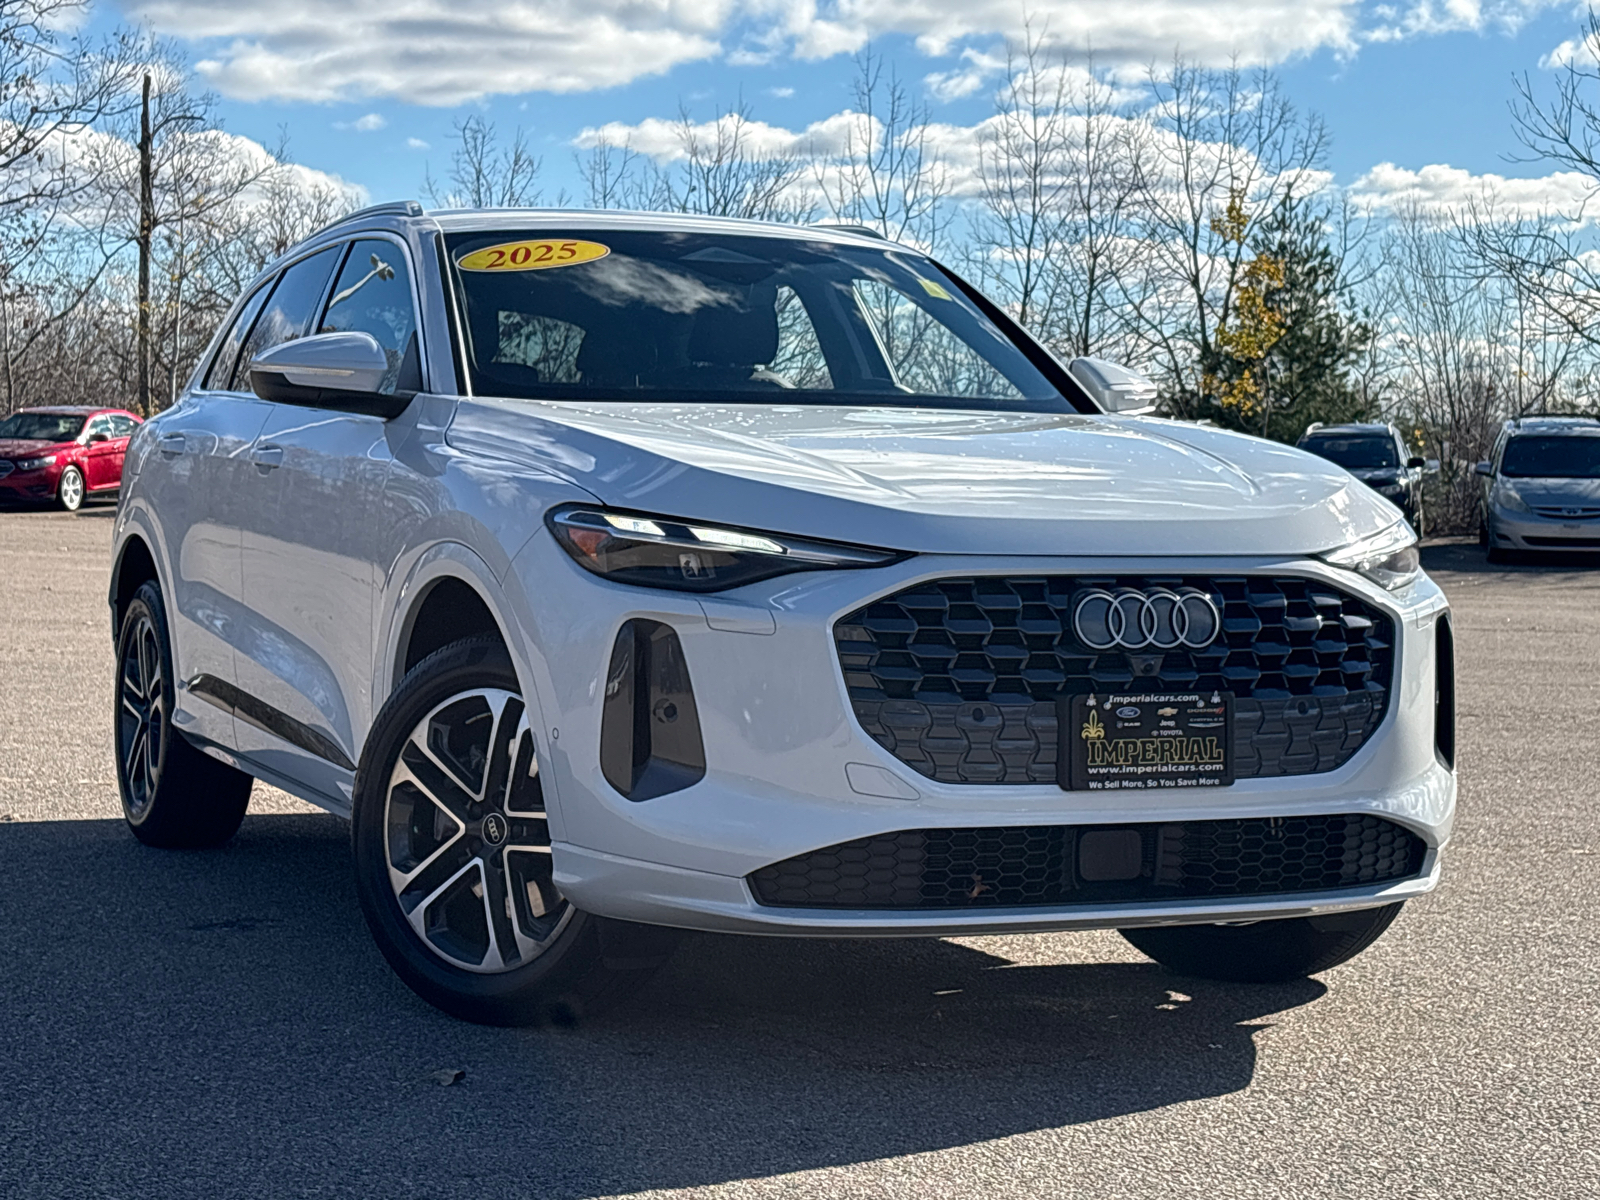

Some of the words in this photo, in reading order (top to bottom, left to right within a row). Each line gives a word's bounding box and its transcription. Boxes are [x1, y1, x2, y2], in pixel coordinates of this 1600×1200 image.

[485, 242, 578, 269] 2025
[1109, 694, 1199, 705] Imperialcars.com
[1159, 719, 1176, 728] Jeep
[1087, 737, 1224, 765] IMPERIAL
[1087, 763, 1224, 774] www.imperialcars.com
[1089, 781, 1103, 789] We
[1104, 780, 1120, 788] Sell
[1122, 780, 1145, 789] More,
[1147, 780, 1158, 788] So
[1159, 779, 1175, 787] You
[1177, 778, 1197, 787] Save
[1199, 778, 1220, 786] More
